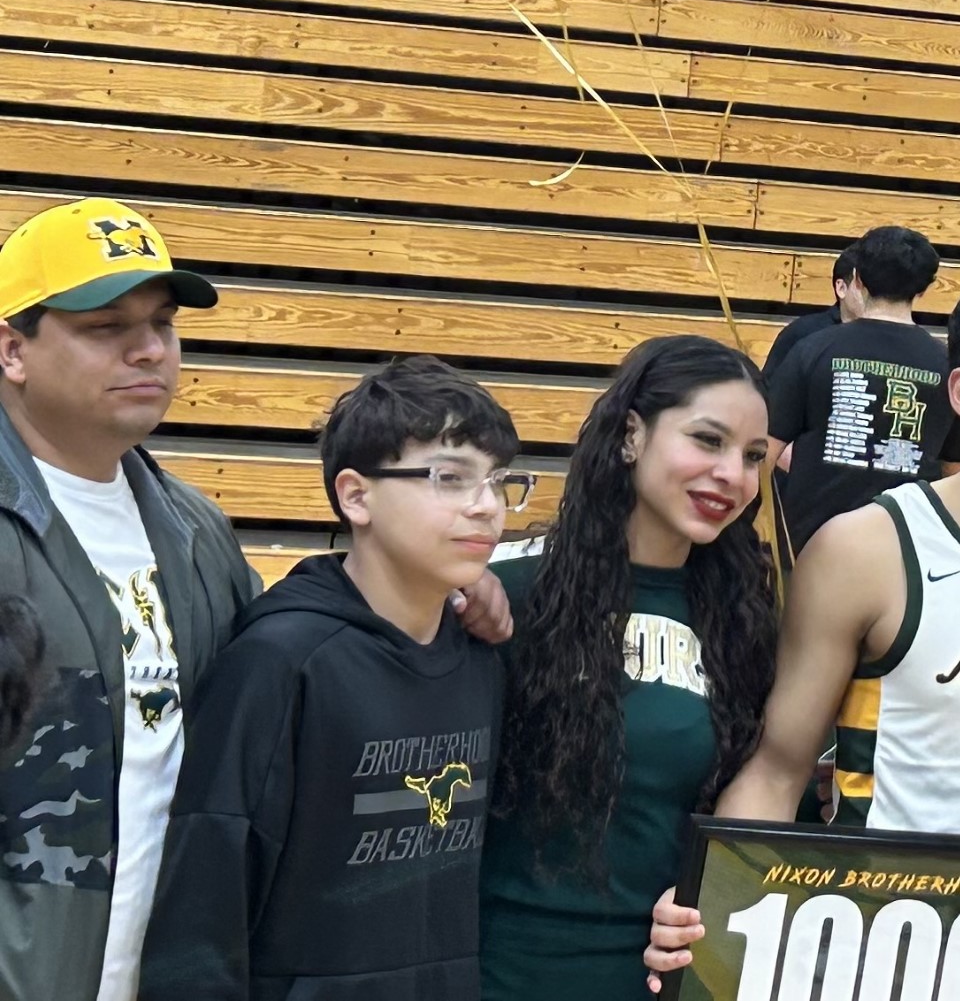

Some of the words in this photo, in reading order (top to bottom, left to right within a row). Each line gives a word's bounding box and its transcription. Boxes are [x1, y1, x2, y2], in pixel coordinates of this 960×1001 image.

[90, 216, 159, 261] M
[352, 727, 490, 777] BROTHERHO
[347, 816, 484, 865] BASKETBA
[763, 863, 836, 887] NIXON
